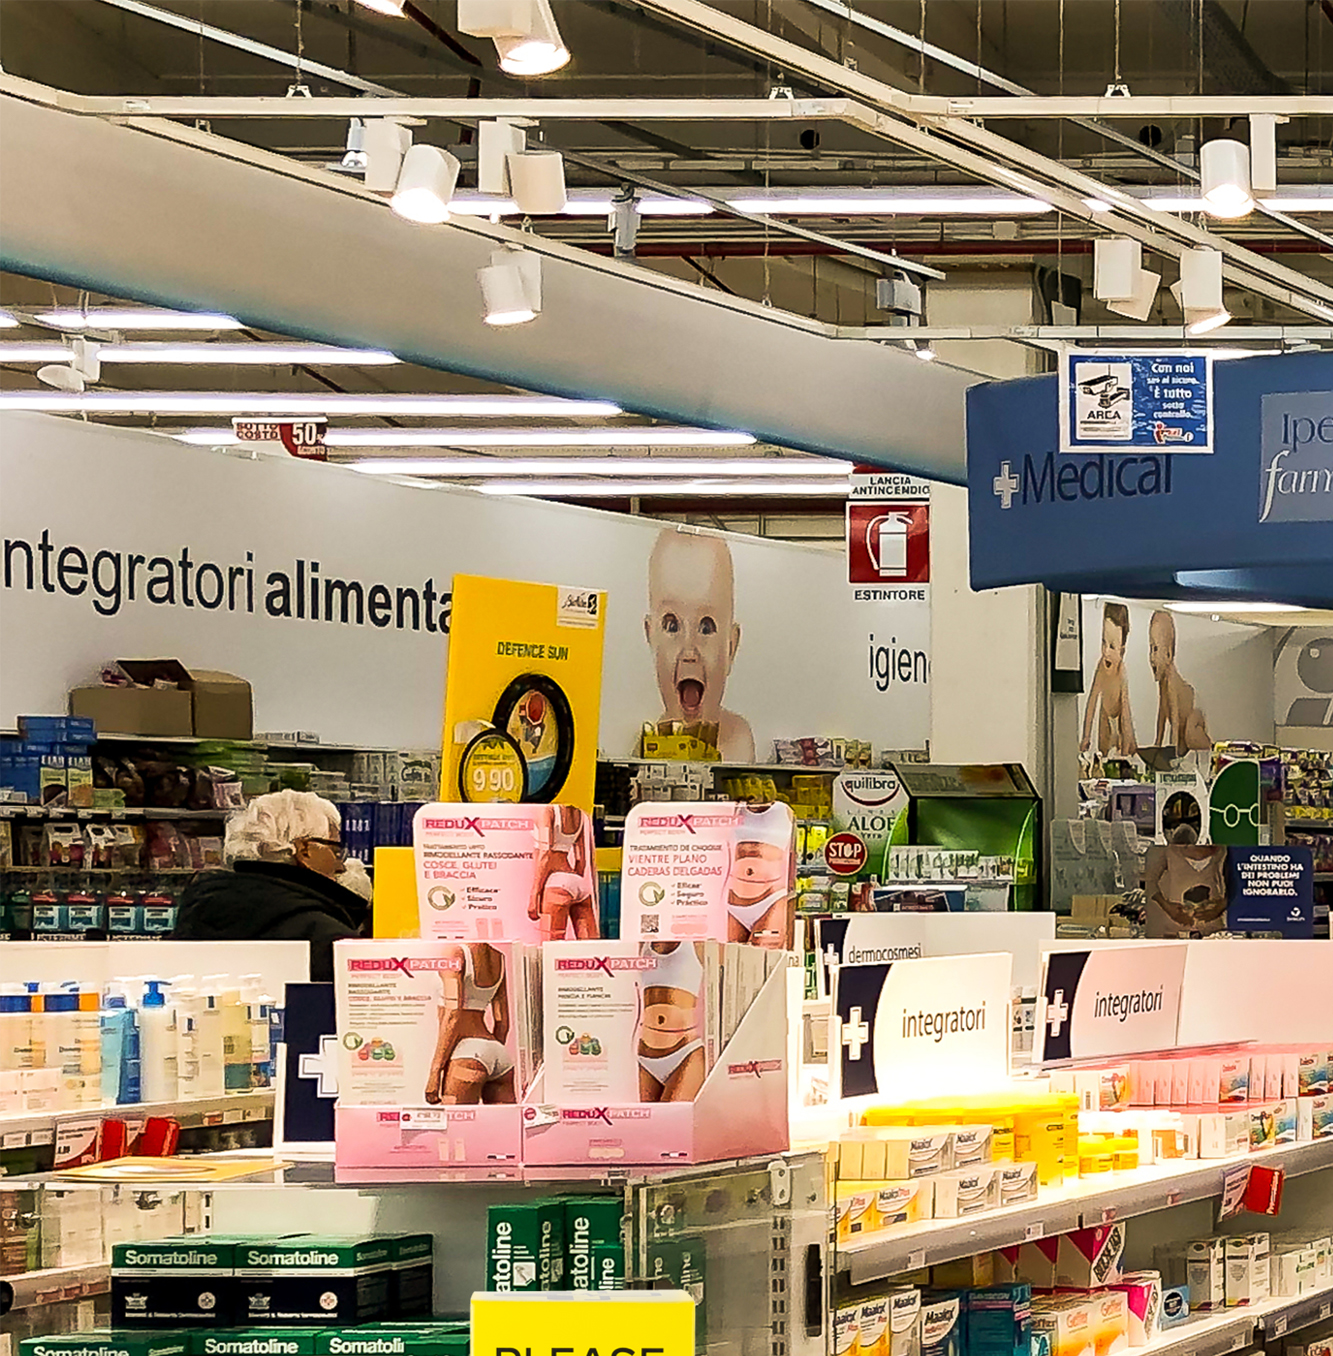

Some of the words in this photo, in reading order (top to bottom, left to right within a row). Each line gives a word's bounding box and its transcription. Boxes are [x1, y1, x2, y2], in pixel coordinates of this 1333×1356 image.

[870, 476, 911, 486] LANCIA
[1022, 452, 1173, 504] Medical
[851, 485, 931, 496] ANTINCENDIO
[854, 589, 926, 601] ESTINTORE
[497, 641, 545, 660] DEFENCE
[547, 644, 569, 660] SUN
[828, 842, 862, 858] STOP
[628, 853, 670, 865] VIENTRE
[673, 854, 707, 865] PLANO
[1250, 854, 1291, 863] QUANDO
[627, 866, 671, 877] CADERAS
[672, 866, 723, 877] DELGADAS
[1247, 879, 1269, 888] NON
[1093, 984, 1163, 1021] integratori
[901, 1002, 986, 1046] integratori
[125, 1249, 218, 1267] Somatoline
[247, 1250, 339, 1267] Somatoline
[924, 1309, 955, 1327] Maalox
[204, 1338, 299, 1355] Somatoline
